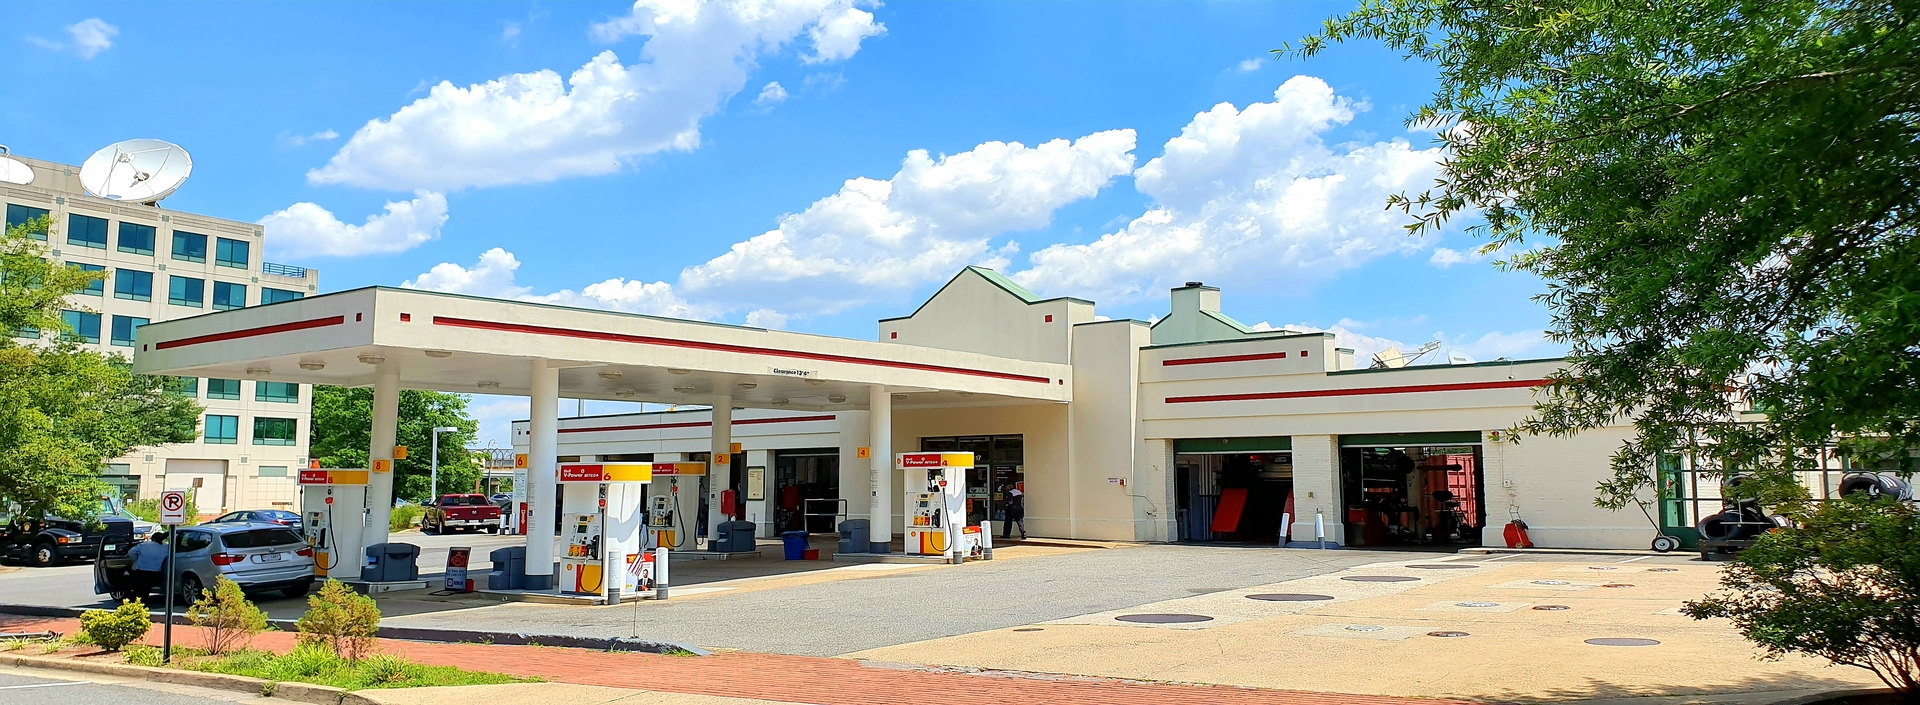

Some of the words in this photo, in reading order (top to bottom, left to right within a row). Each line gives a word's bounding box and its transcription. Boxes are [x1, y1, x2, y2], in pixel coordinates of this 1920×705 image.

[518, 456, 523, 466] 6
[717, 455, 723, 463] 2
[375, 461, 381, 470] 8
[603, 472, 611, 481] 6
